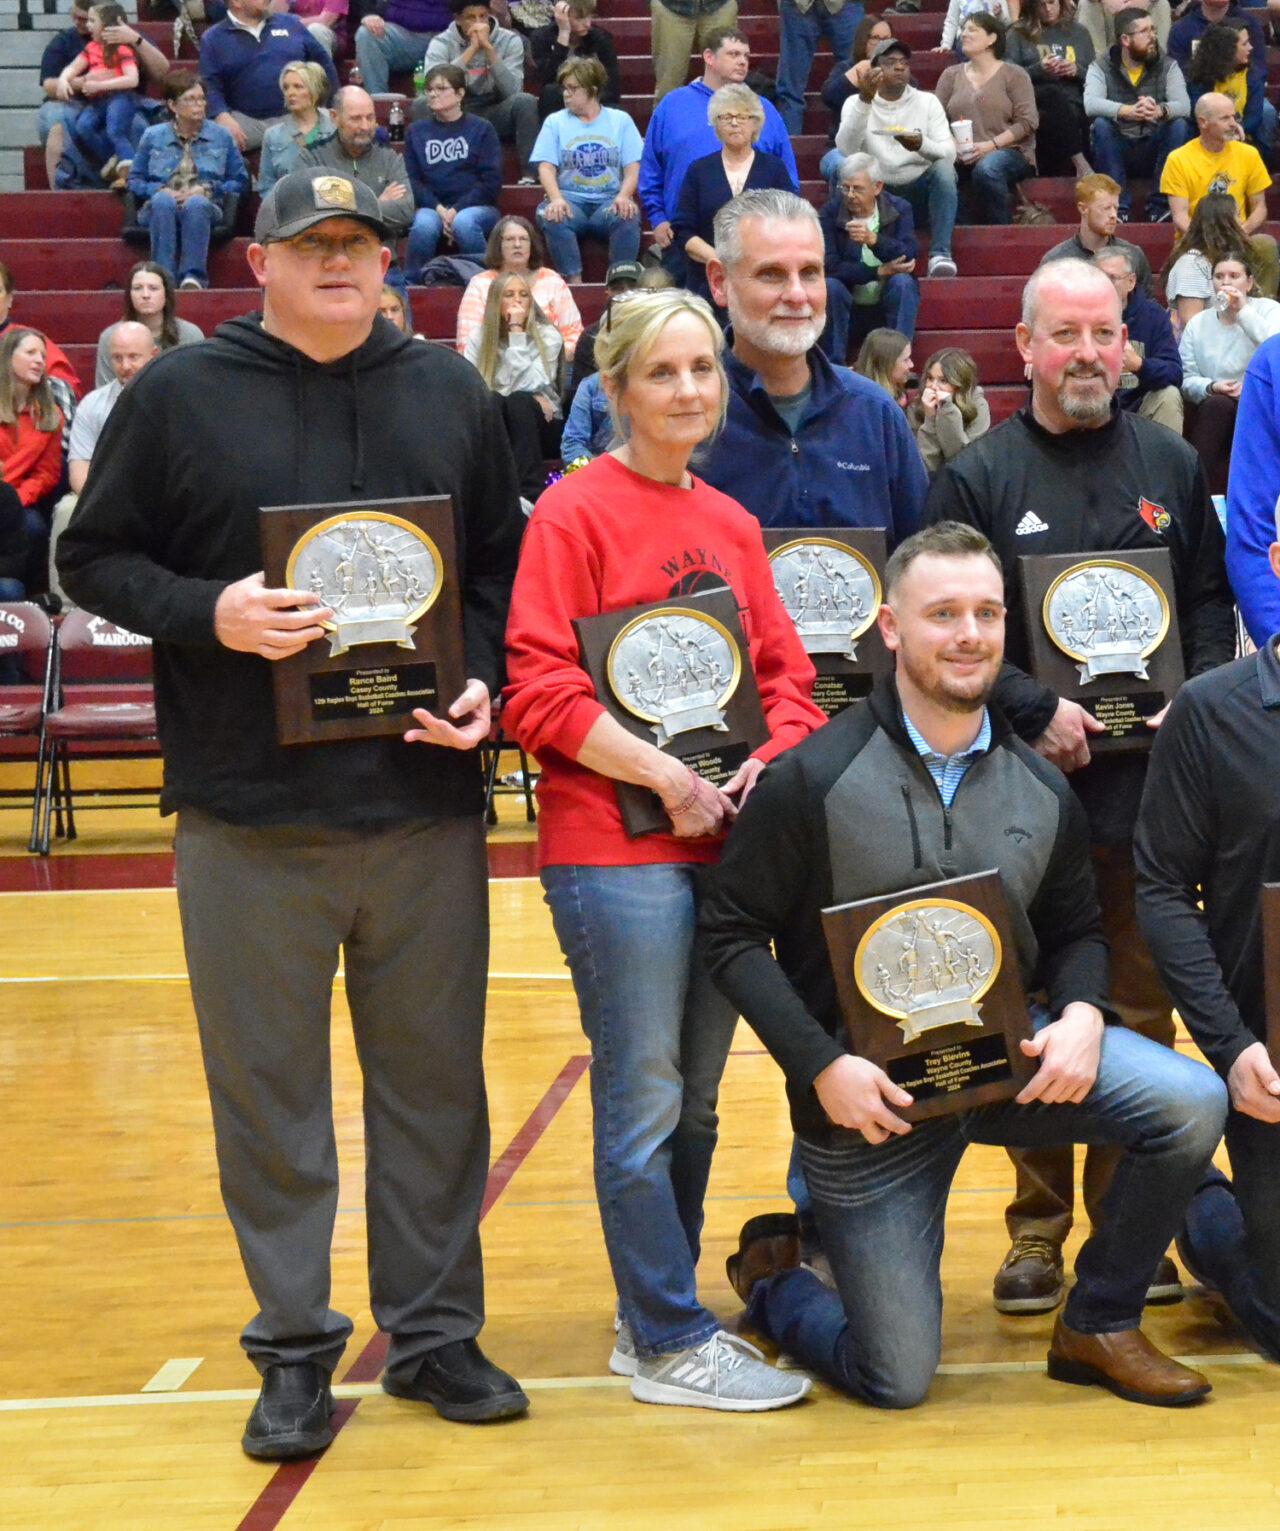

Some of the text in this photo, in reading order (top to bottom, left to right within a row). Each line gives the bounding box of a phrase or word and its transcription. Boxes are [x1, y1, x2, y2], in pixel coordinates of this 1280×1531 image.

[425, 136, 469, 165] DCA
[842, 461, 870, 471] Columbia
[1015, 522, 1049, 536] adidas
[349, 674, 397, 685] Rance Baird
[350, 686, 371, 694] Casey
[698, 757, 721, 767] Woods
[925, 1051, 971, 1066] Trey Blevins
[926, 1060, 972, 1074] Wayne County
